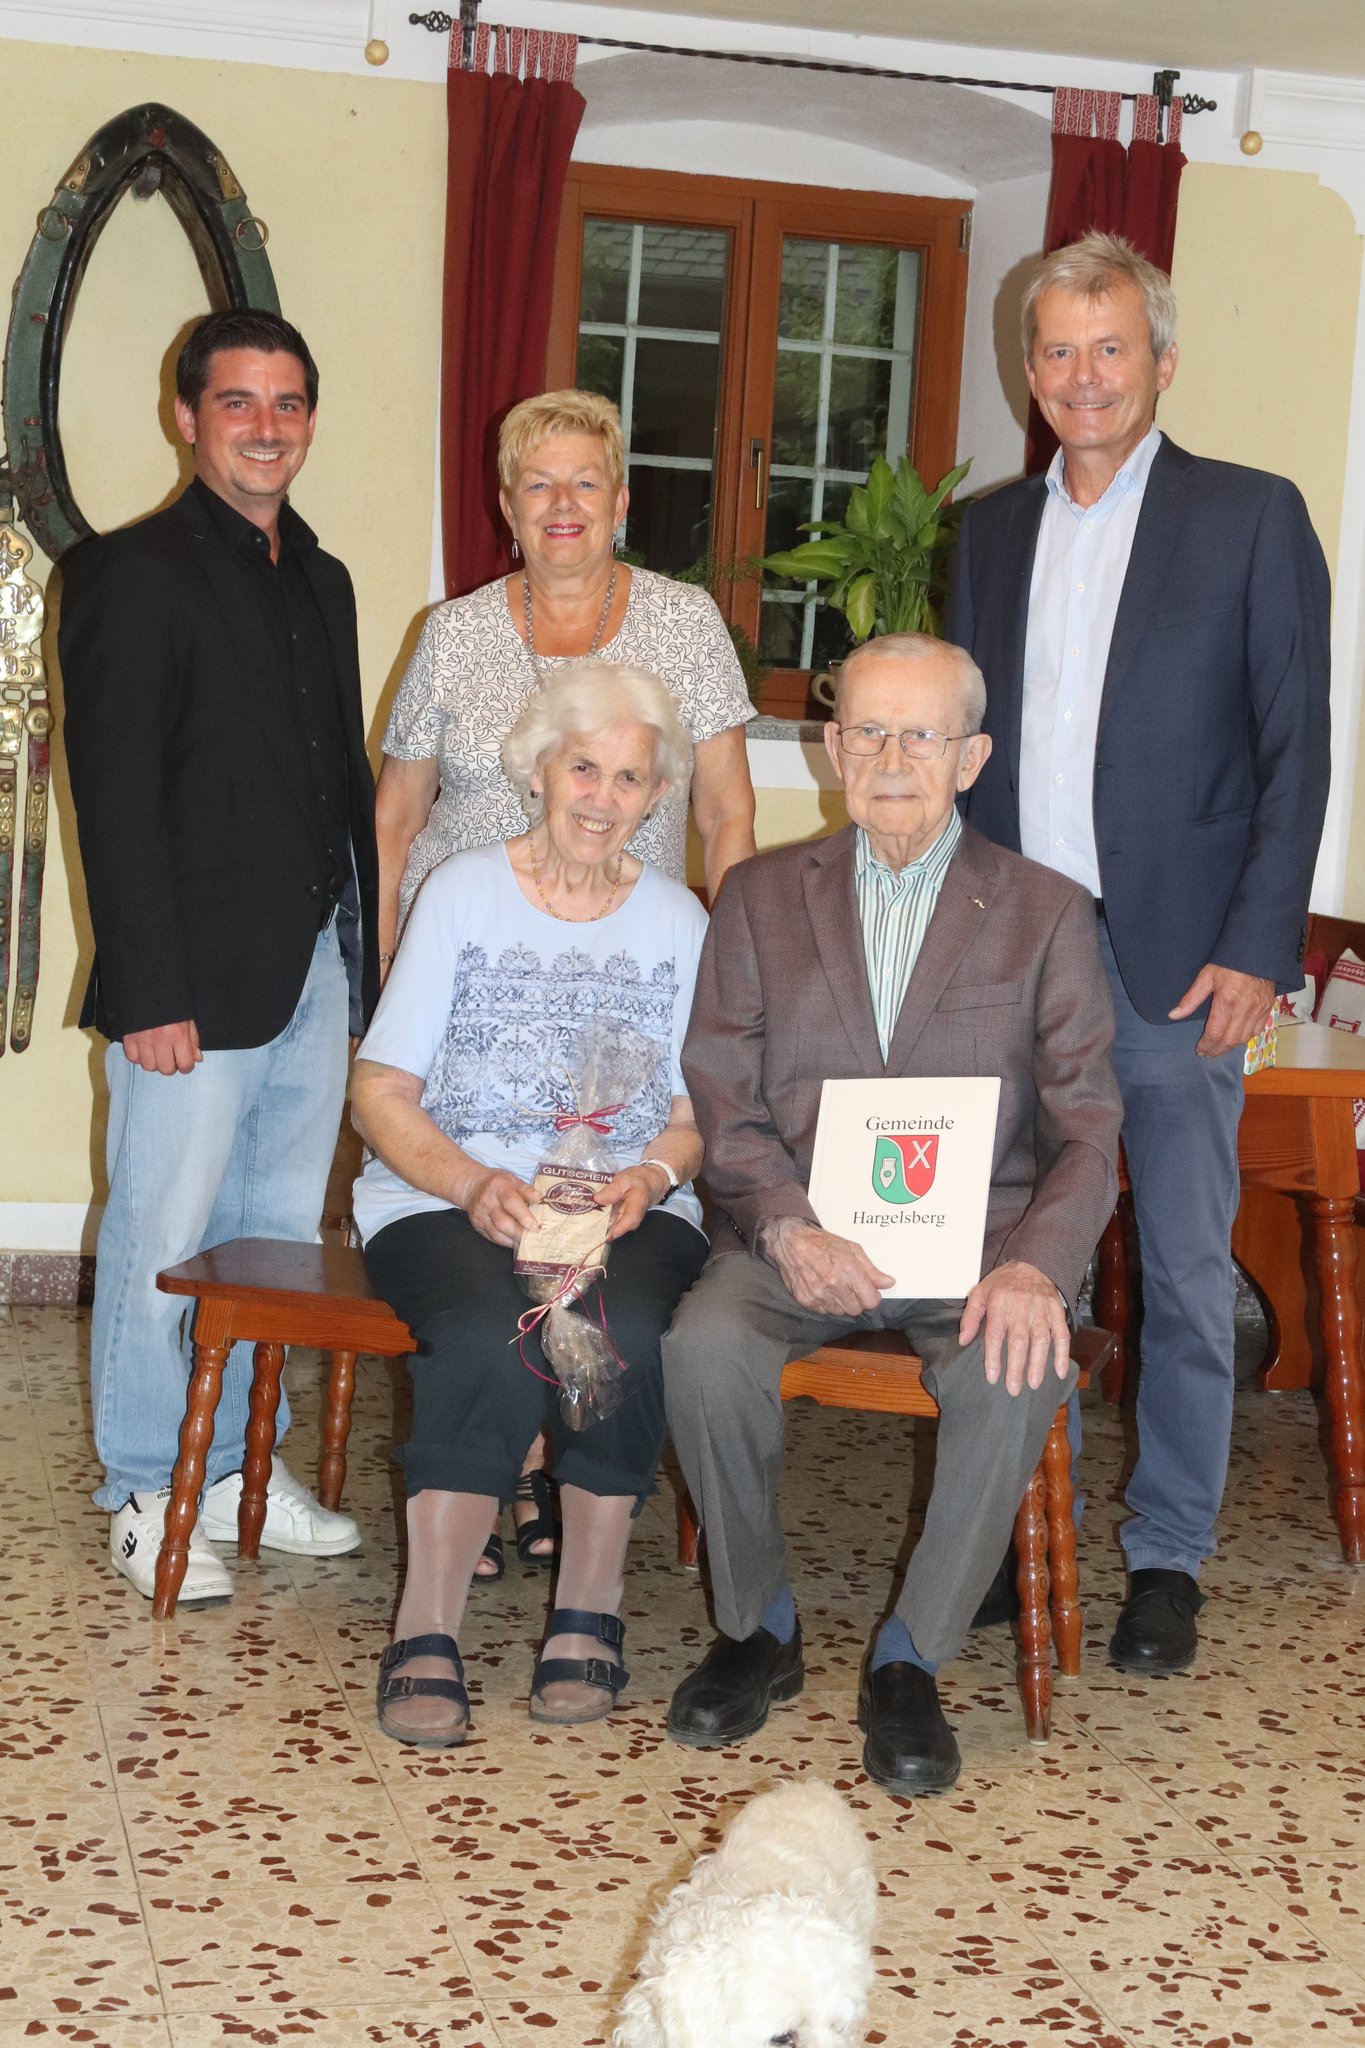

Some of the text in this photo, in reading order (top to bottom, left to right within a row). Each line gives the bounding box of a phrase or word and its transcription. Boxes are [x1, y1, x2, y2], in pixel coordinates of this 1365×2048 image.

[865, 1115, 955, 1131] Gemeinde
[542, 1166, 613, 1183] GUTSCHEIN
[852, 1211, 946, 1228] Hargelsberg
